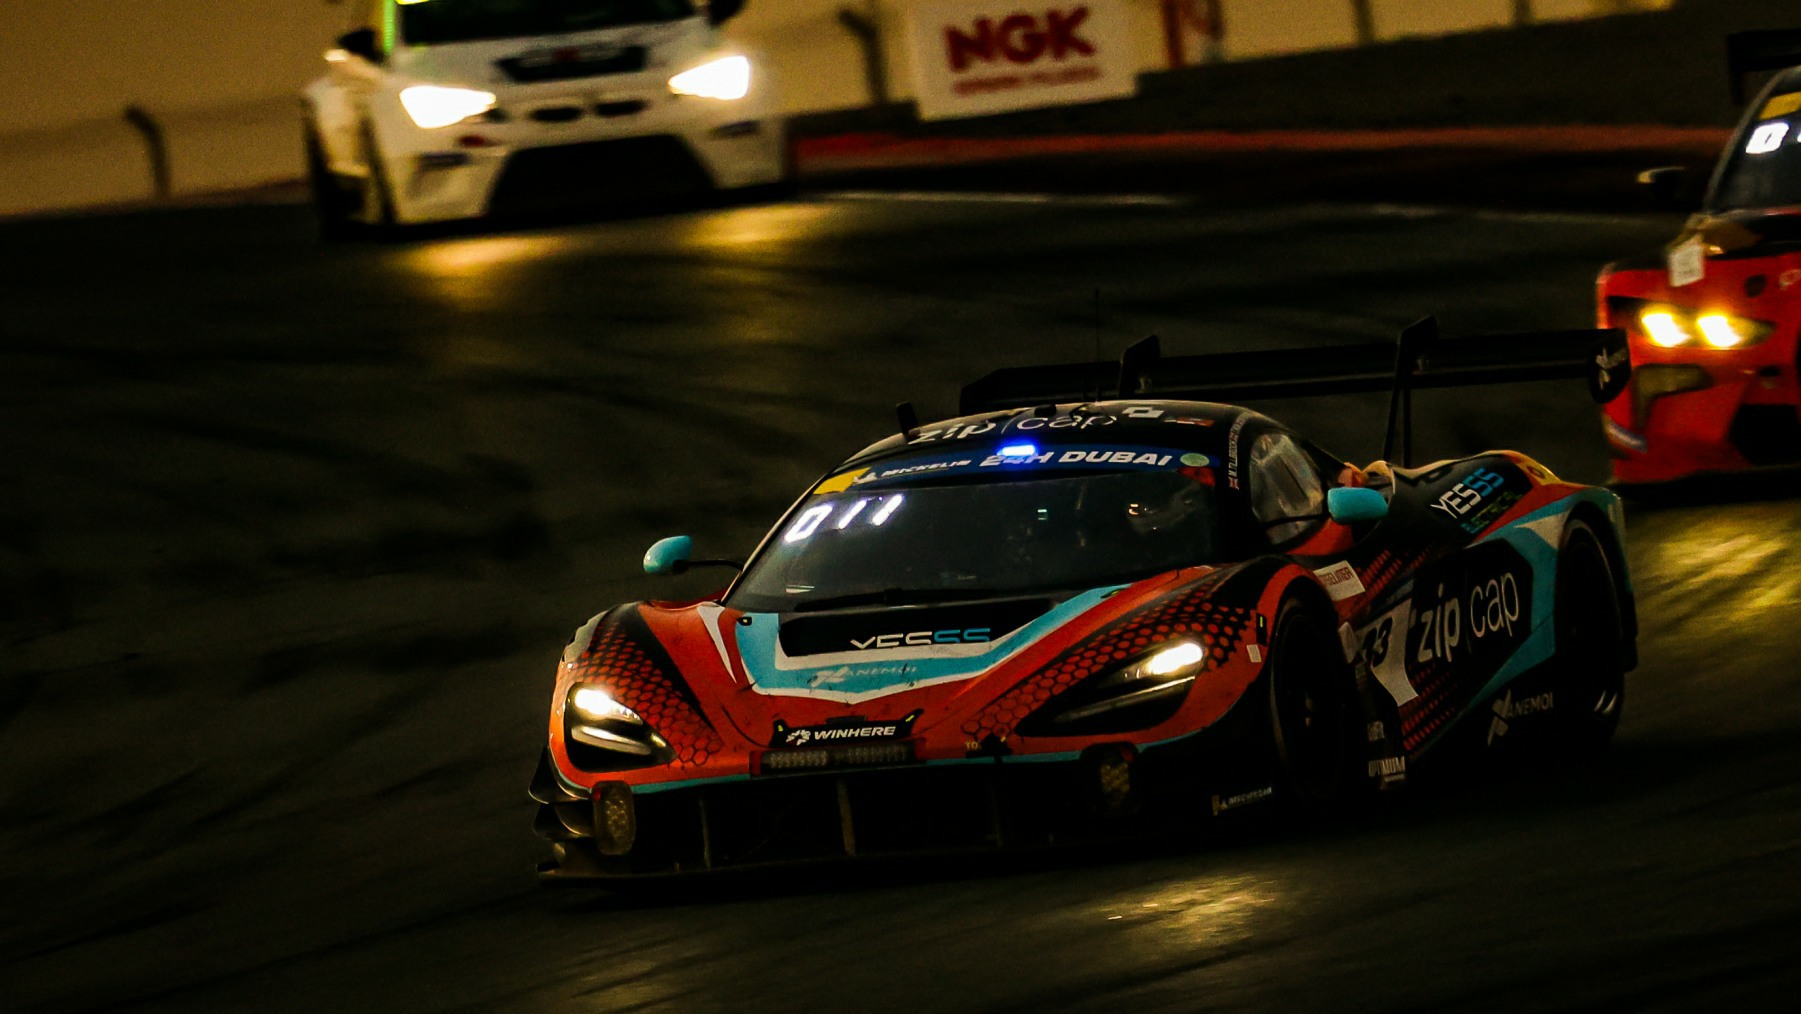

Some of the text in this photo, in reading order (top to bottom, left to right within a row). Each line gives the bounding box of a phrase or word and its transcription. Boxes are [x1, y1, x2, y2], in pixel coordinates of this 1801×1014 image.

[944, 6, 1095, 73] NGK
[1058, 451, 1173, 466] DUBAI
[783, 493, 903, 543] 011
[1429, 467, 1505, 519] YESSS
[1417, 572, 1520, 663] zip cap
[1507, 690, 1554, 719] ANEMOI
[814, 725, 897, 741] WINHERE
